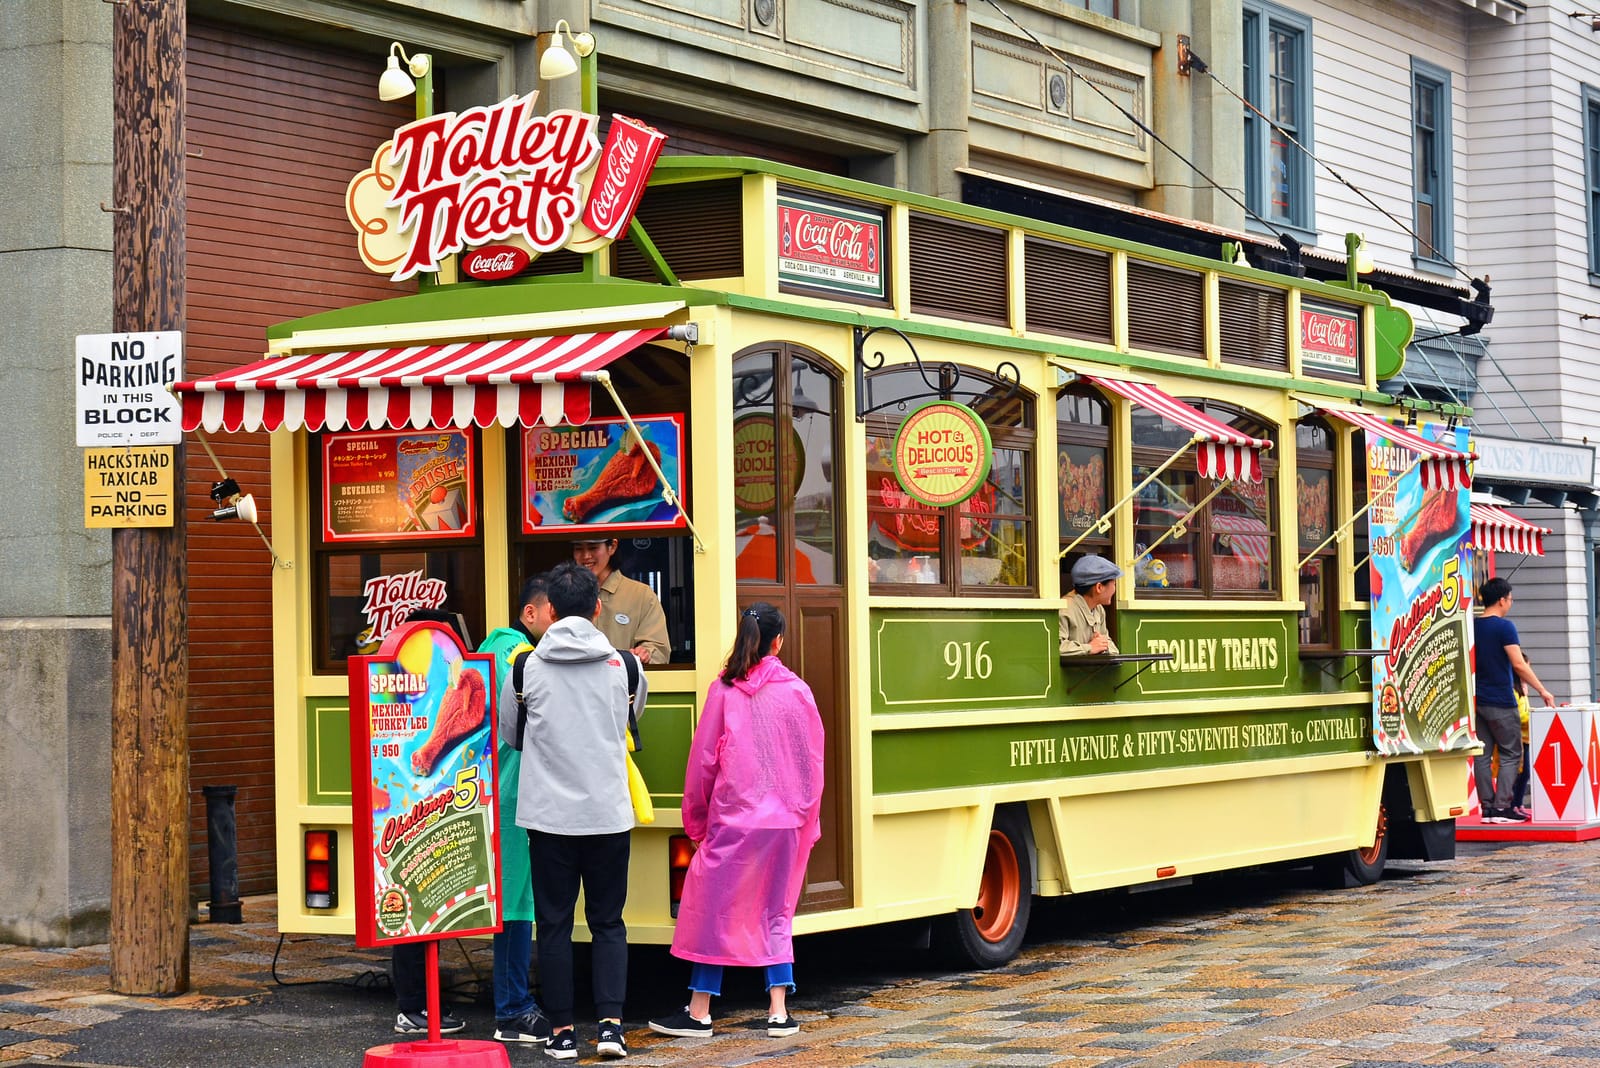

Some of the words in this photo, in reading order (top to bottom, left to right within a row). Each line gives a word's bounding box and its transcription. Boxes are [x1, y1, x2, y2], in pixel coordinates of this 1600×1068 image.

[390, 102, 597, 201] Trolley
[591, 126, 639, 230] Coca-Cola
[400, 166, 575, 275] Treats
[795, 214, 864, 260] Coca-Cola
[470, 252, 516, 274] Coca-Cola
[1308, 315, 1346, 348] Coca-Cola
[111, 341, 145, 361] NO
[82, 354, 176, 388] PARKING
[104, 394, 118, 404] IN
[122, 393, 153, 404] THIS
[84, 408, 172, 424] BLOCK
[346, 440, 379, 452] SPECIAL
[436, 435, 450, 452] 5
[540, 430, 607, 450] SPECIAL
[918, 430, 952, 444] HOT
[953, 431, 964, 442] &
[88, 453, 169, 470] HACKSTAND
[536, 454, 577, 467] MEXICAN
[908, 444, 974, 466] DELICIOUS
[100, 472, 158, 486] TAXICAB
[536, 467, 573, 480] TURKEY
[342, 484, 386, 496] BEVERAGES
[536, 480, 554, 492] LEG
[116, 491, 141, 502] NO
[91, 504, 167, 517] PARKING
[1372, 508, 1384, 524] LEG
[366, 575, 444, 610] Trolley
[1442, 559, 1459, 612] 5
[944, 640, 992, 680] 916
[1147, 638, 1217, 674] TROLLEY
[1222, 638, 1278, 672] TREATS
[370, 674, 426, 694] SPECIAL
[372, 704, 412, 718] MEXICAN
[372, 717, 408, 731] TURKEY
[410, 717, 428, 730] LEG
[372, 745, 378, 758] ¥
[382, 744, 399, 757] 950
[1010, 738, 1056, 766] FIFTH
[1060, 734, 1118, 763] AVENUE
[1122, 734, 1134, 758] &
[1138, 726, 1238, 756] FIFTY-SEVENTH
[1242, 722, 1288, 749] STREET
[1291, 728, 1304, 744] to
[1306, 718, 1358, 742] CENTRAL
[1550, 741, 1566, 787] 1
[380, 790, 454, 854] Challenge
[454, 766, 478, 810] 5
